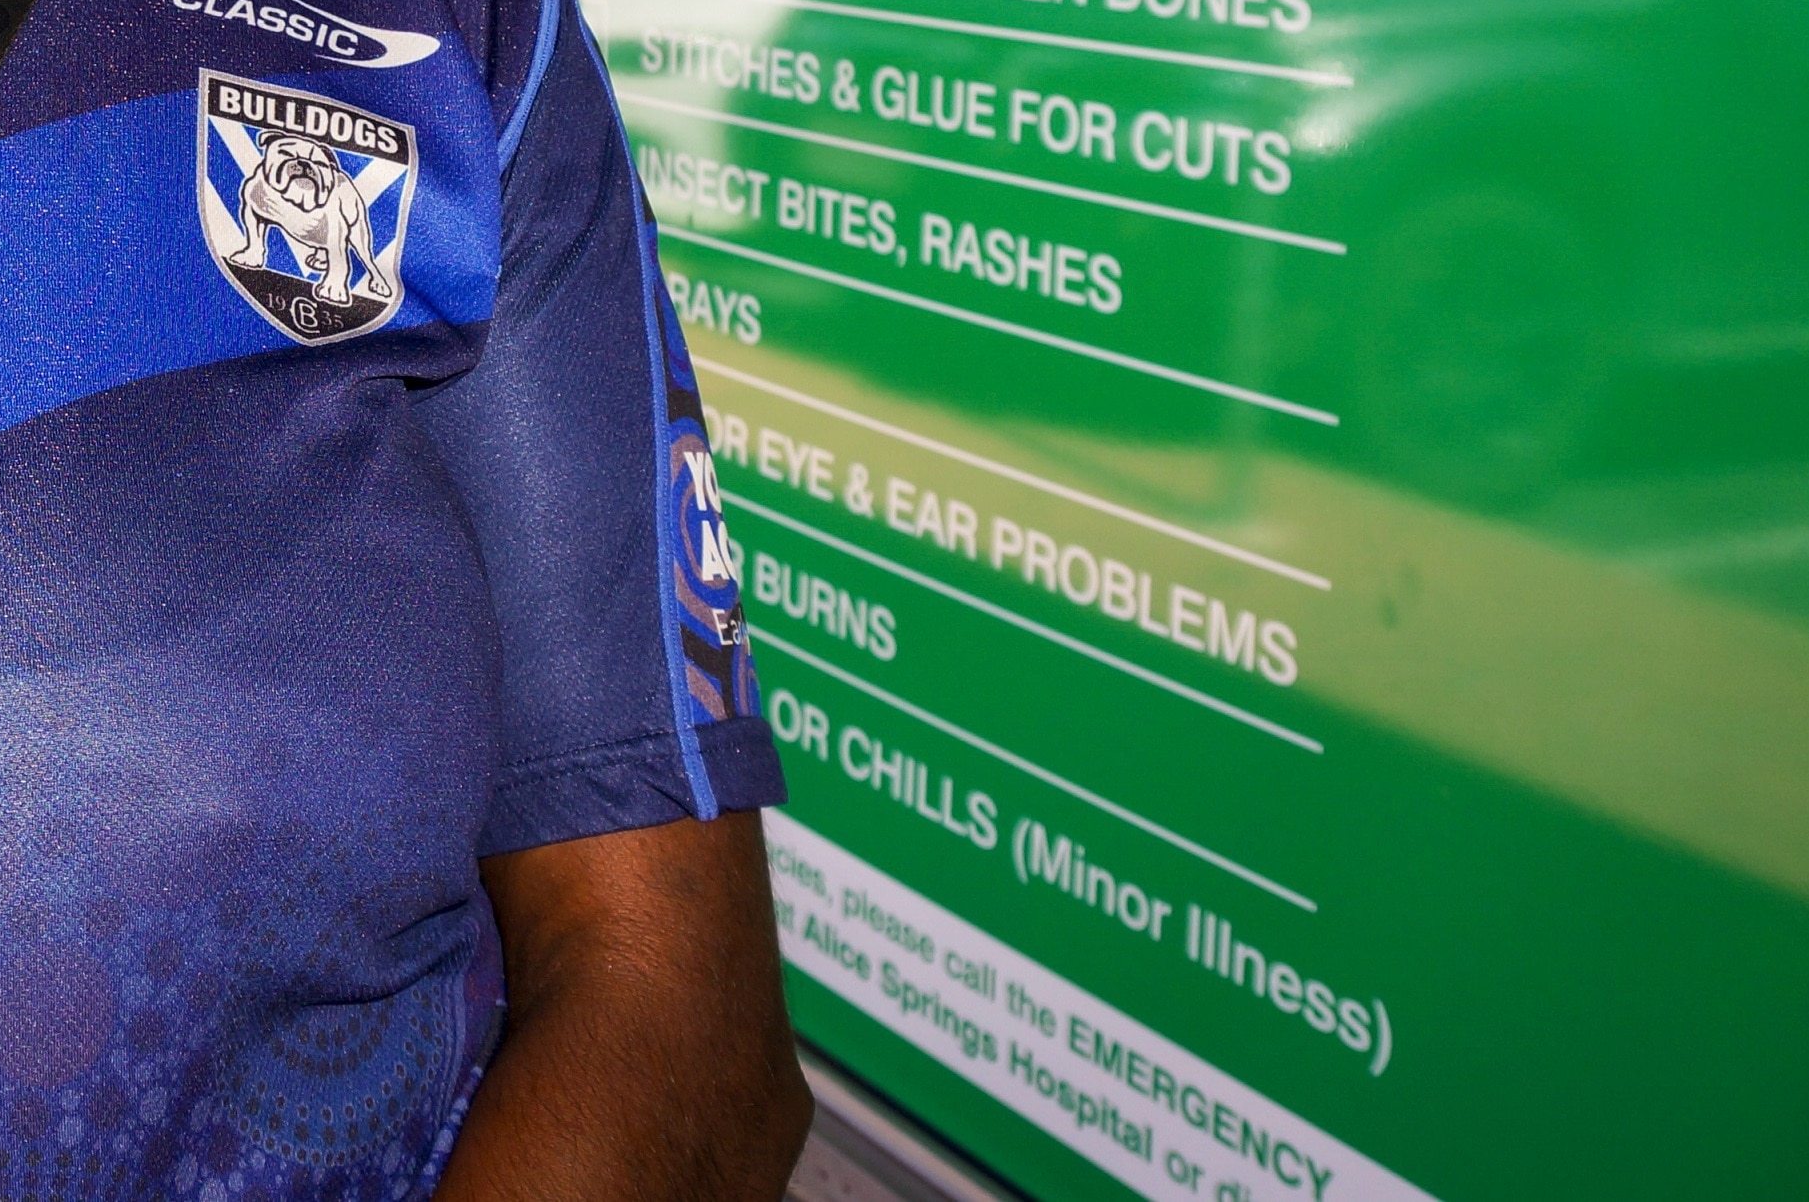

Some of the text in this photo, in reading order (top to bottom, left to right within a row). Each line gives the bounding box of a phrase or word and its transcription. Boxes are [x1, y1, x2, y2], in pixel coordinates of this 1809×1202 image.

[218, 85, 399, 155] BULLDOGS
[640, 27, 1292, 195] STITCHES & GLUE FOR CUTS
[637, 144, 1124, 315] INSECT BITES, RASHES
[666, 270, 763, 347] RAYS
[683, 451, 722, 513] YO
[702, 403, 1300, 689] OR EYE & EAR PROBLEMS
[754, 560, 898, 663] BURNS
[770, 686, 1394, 1077] OR CHILLS (Minor Illness)
[803, 910, 872, 979] Alice
[880, 958, 998, 1070] Springs
[1008, 1044, 1154, 1164] Hospital
[1165, 1147, 1211, 1196] or
[843, 880, 936, 969] please
[944, 942, 996, 1004] call
[1005, 975, 1057, 1038] the
[1068, 1016, 1334, 1200] EMERGENCY
